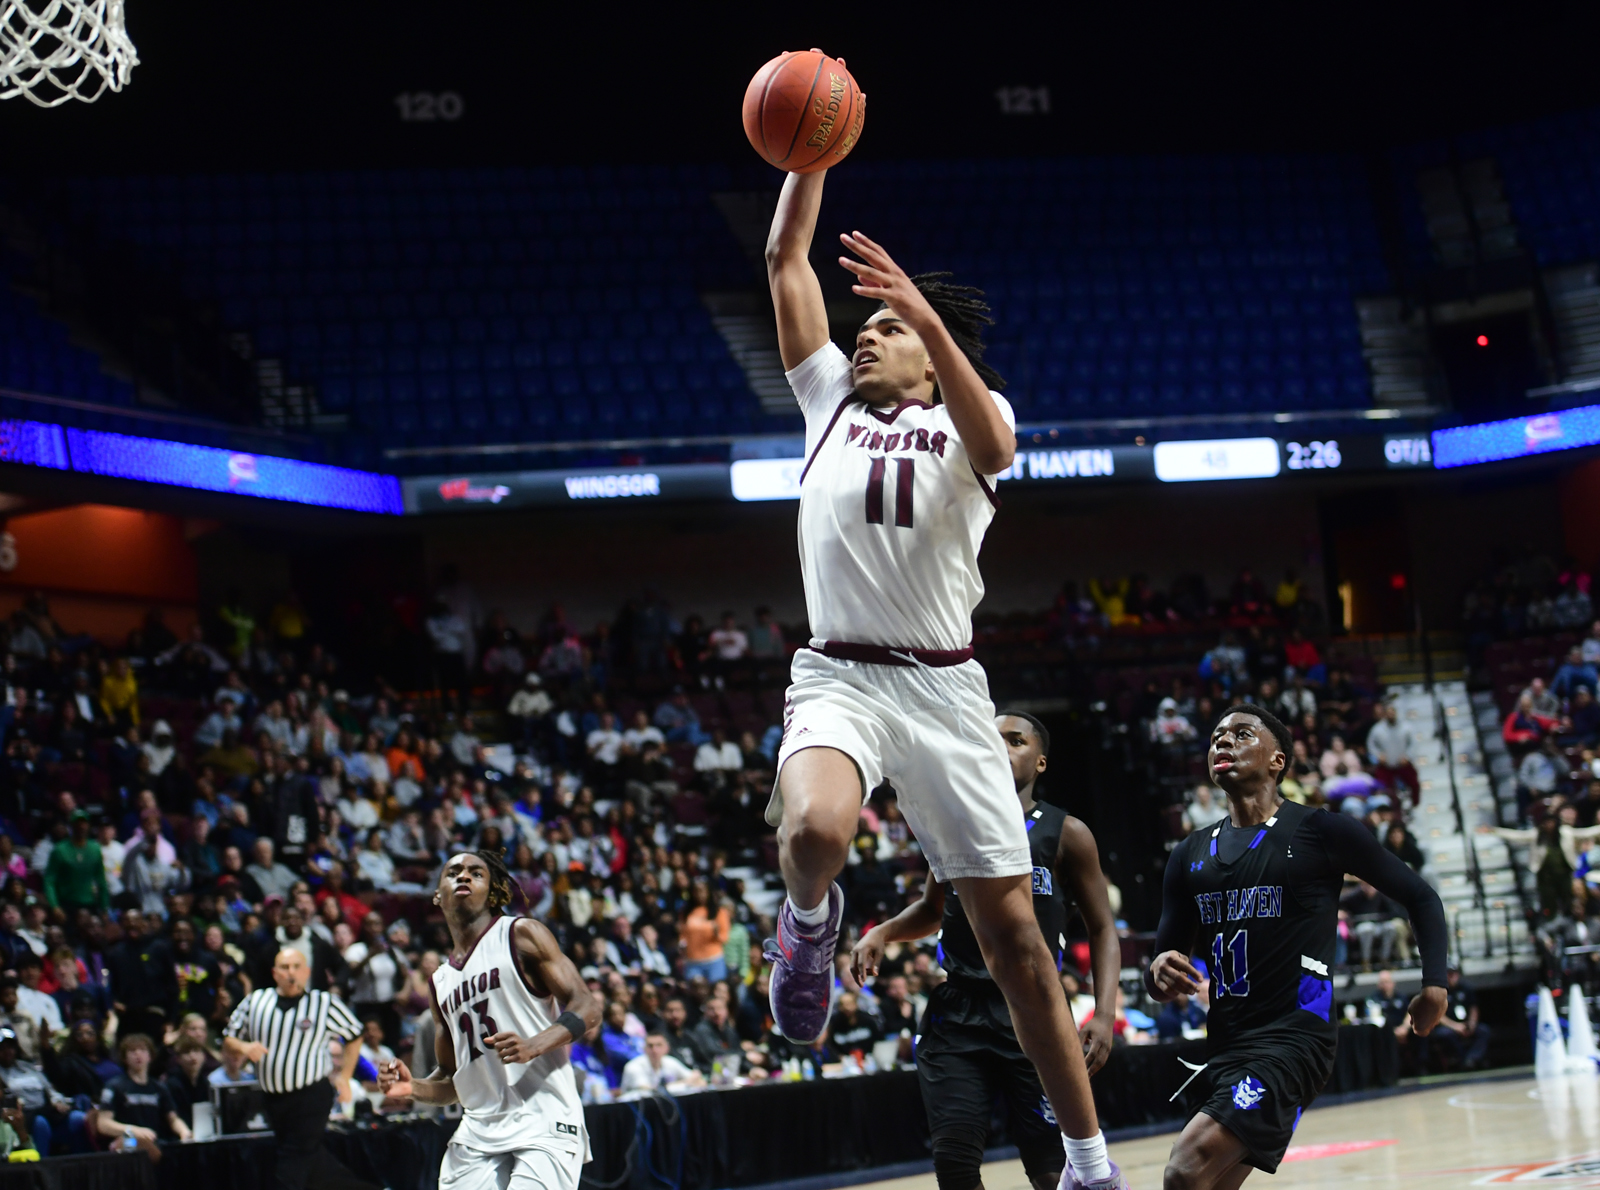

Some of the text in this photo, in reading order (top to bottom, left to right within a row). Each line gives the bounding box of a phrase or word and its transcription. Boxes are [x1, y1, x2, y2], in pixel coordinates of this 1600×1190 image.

[394, 90, 465, 121] 120
[805, 72, 848, 152] SPALDING
[995, 85, 1051, 114] 121
[844, 422, 948, 458] WINDSOR
[1286, 439, 1342, 470] 2:26
[1028, 449, 1115, 478] HAVEN
[564, 473, 661, 499] WINDSOR
[865, 454, 915, 529] 11
[1226, 886, 1283, 921] HAVEN
[1211, 929, 1250, 999] 11
[441, 967, 501, 1018] WINDSOR
[458, 998, 500, 1062] 23
